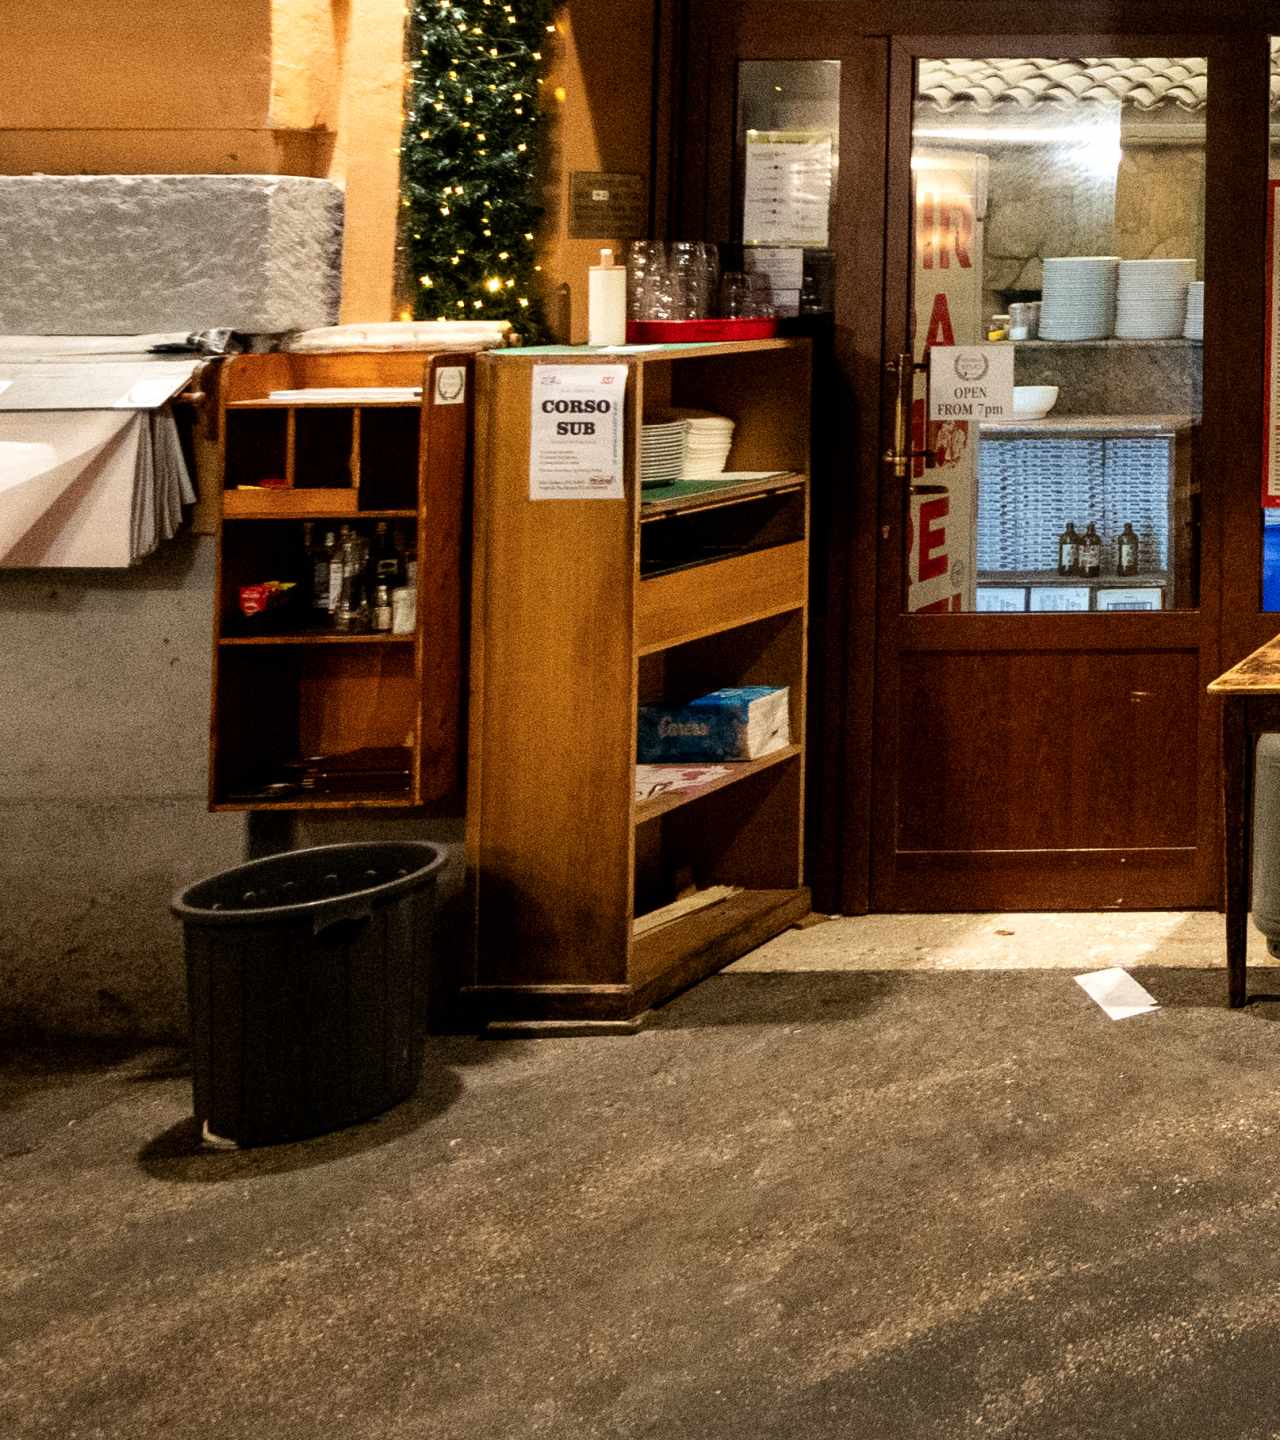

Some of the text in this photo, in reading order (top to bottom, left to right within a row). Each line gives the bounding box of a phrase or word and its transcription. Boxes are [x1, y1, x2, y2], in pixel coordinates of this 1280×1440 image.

[953, 386, 987, 400] OPEN
[541, 399, 611, 414] CORSO
[937, 403, 1004, 418] FROM 7pm
[556, 421, 596, 436] SUB
